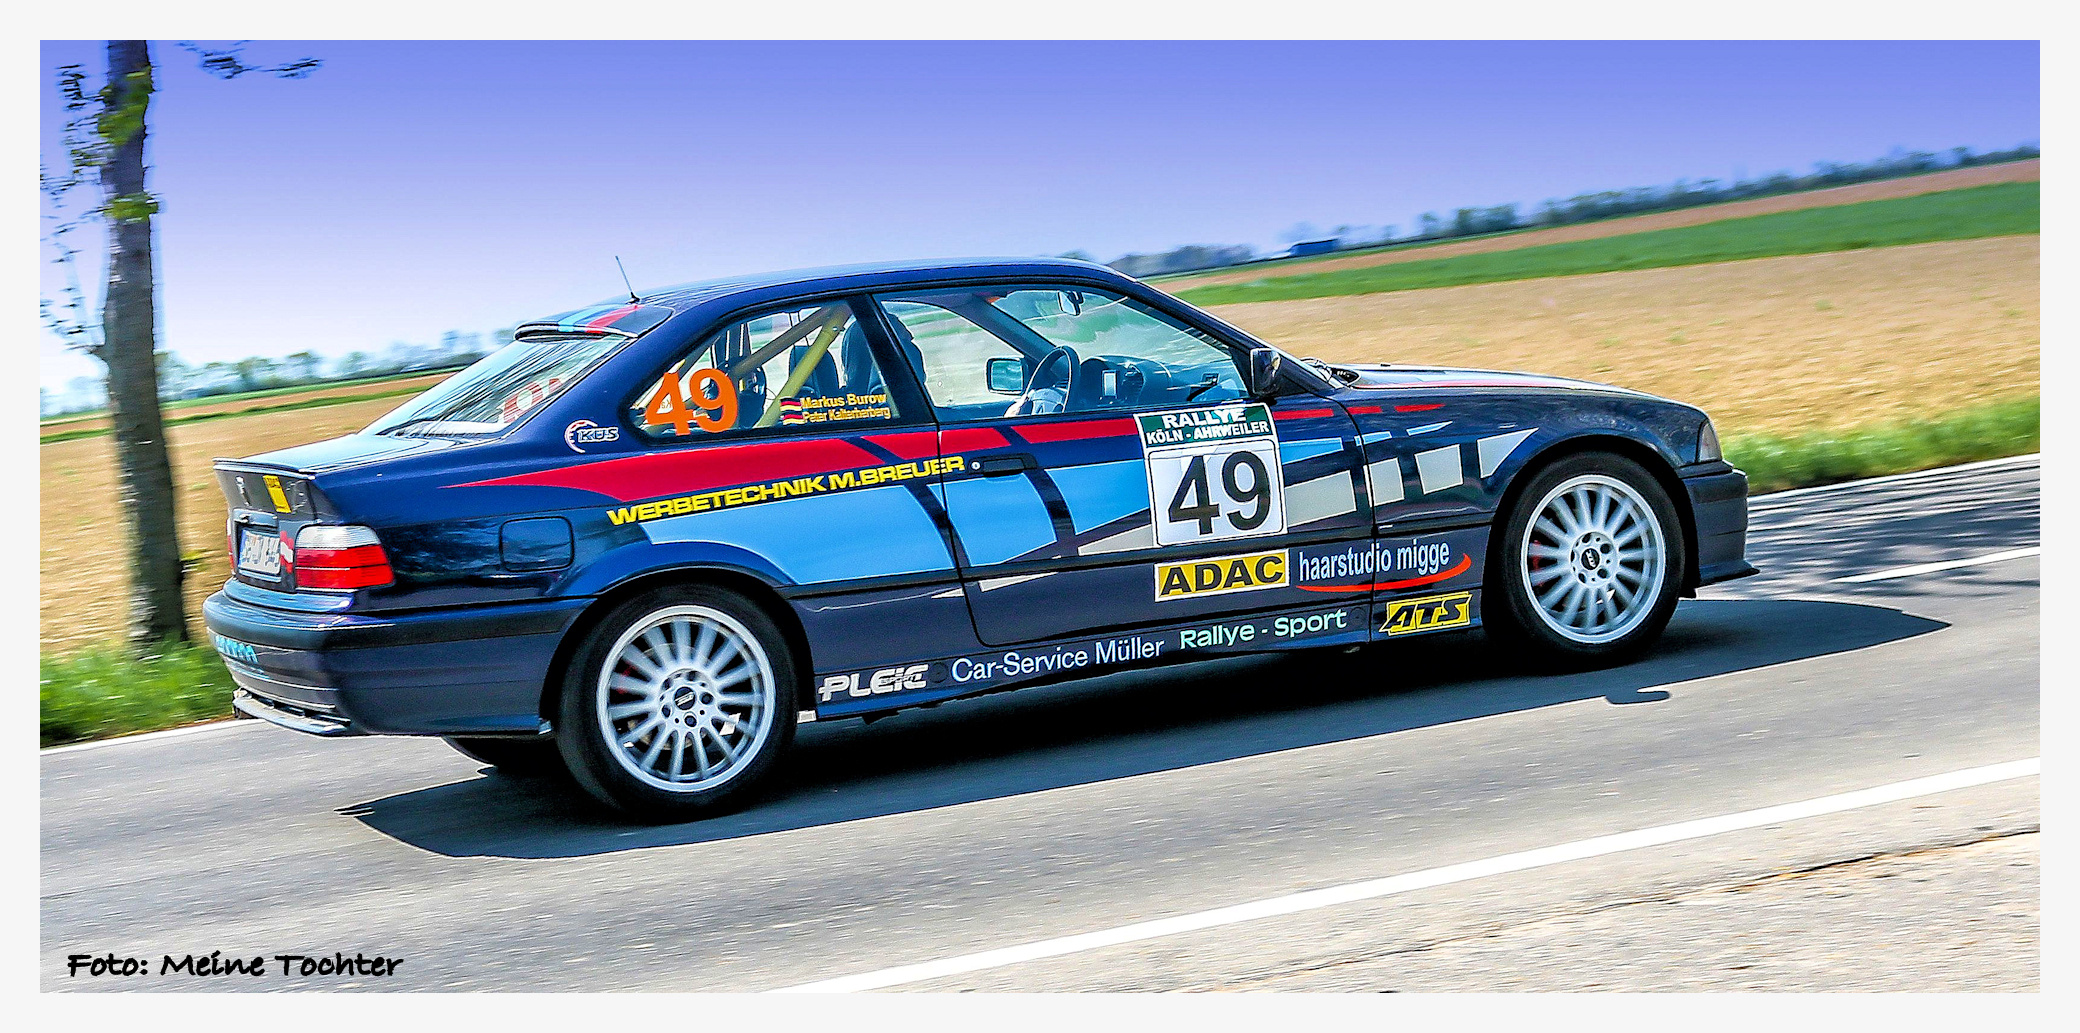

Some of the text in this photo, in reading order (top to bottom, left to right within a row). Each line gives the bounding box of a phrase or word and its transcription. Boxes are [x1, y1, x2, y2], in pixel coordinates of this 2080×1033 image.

[643, 368, 737, 436] 49
[800, 393, 887, 409] Markus Burow
[802, 411, 827, 423] Peter
[1161, 407, 1247, 429] RALLYE
[1146, 429, 1184, 445] KÖLN
[1193, 421, 1270, 440] AHRWEILER
[606, 456, 965, 526] WERBETECHNIK M.BREUER
[1167, 451, 1272, 536] 49
[1160, 556, 1285, 597] ADAC
[1299, 538, 1451, 582] haarstudio migge
[1179, 623, 1256, 650] Rallye
[1273, 608, 1349, 638] Sport
[1386, 600, 1462, 634] ATS
[951, 638, 1164, 682] Car-Service Müller
